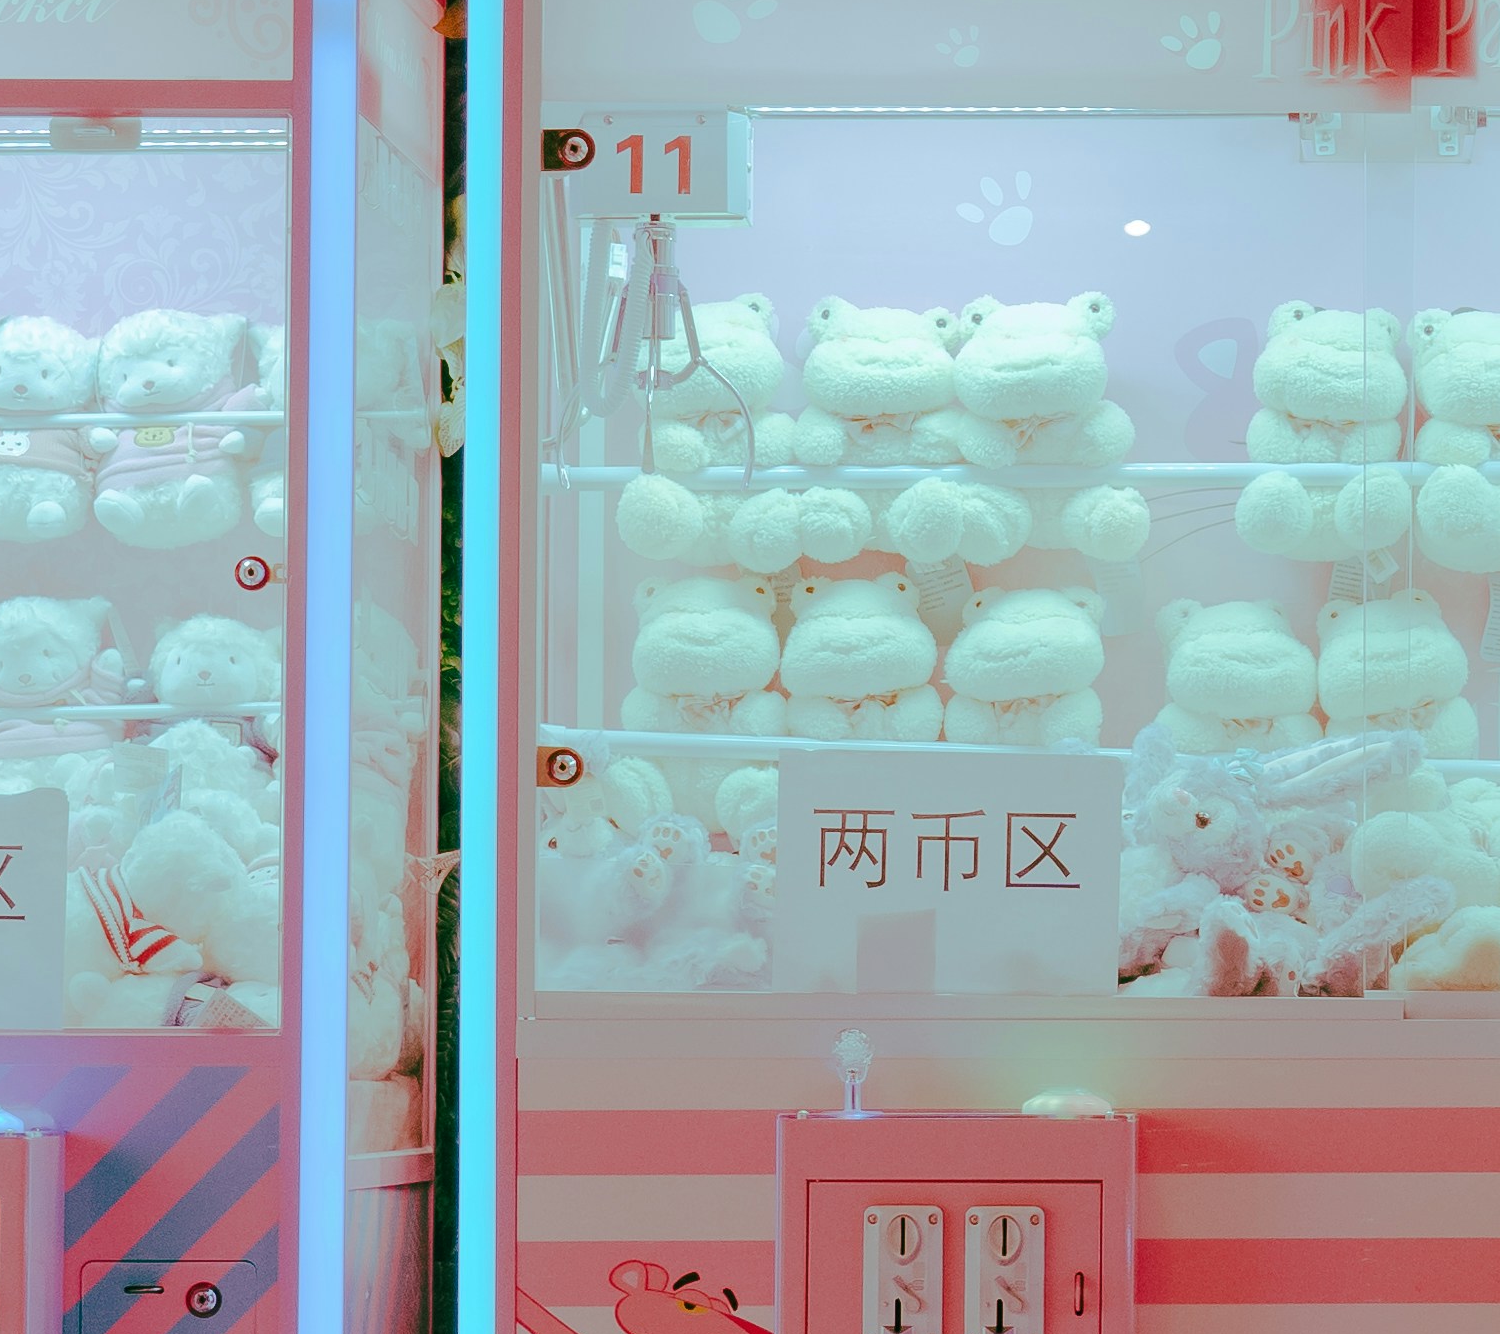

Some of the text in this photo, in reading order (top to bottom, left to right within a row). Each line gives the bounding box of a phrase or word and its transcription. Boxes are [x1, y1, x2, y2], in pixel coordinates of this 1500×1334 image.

[615, 134, 691, 195] 11
[813, 808, 1081, 892] 两币区
